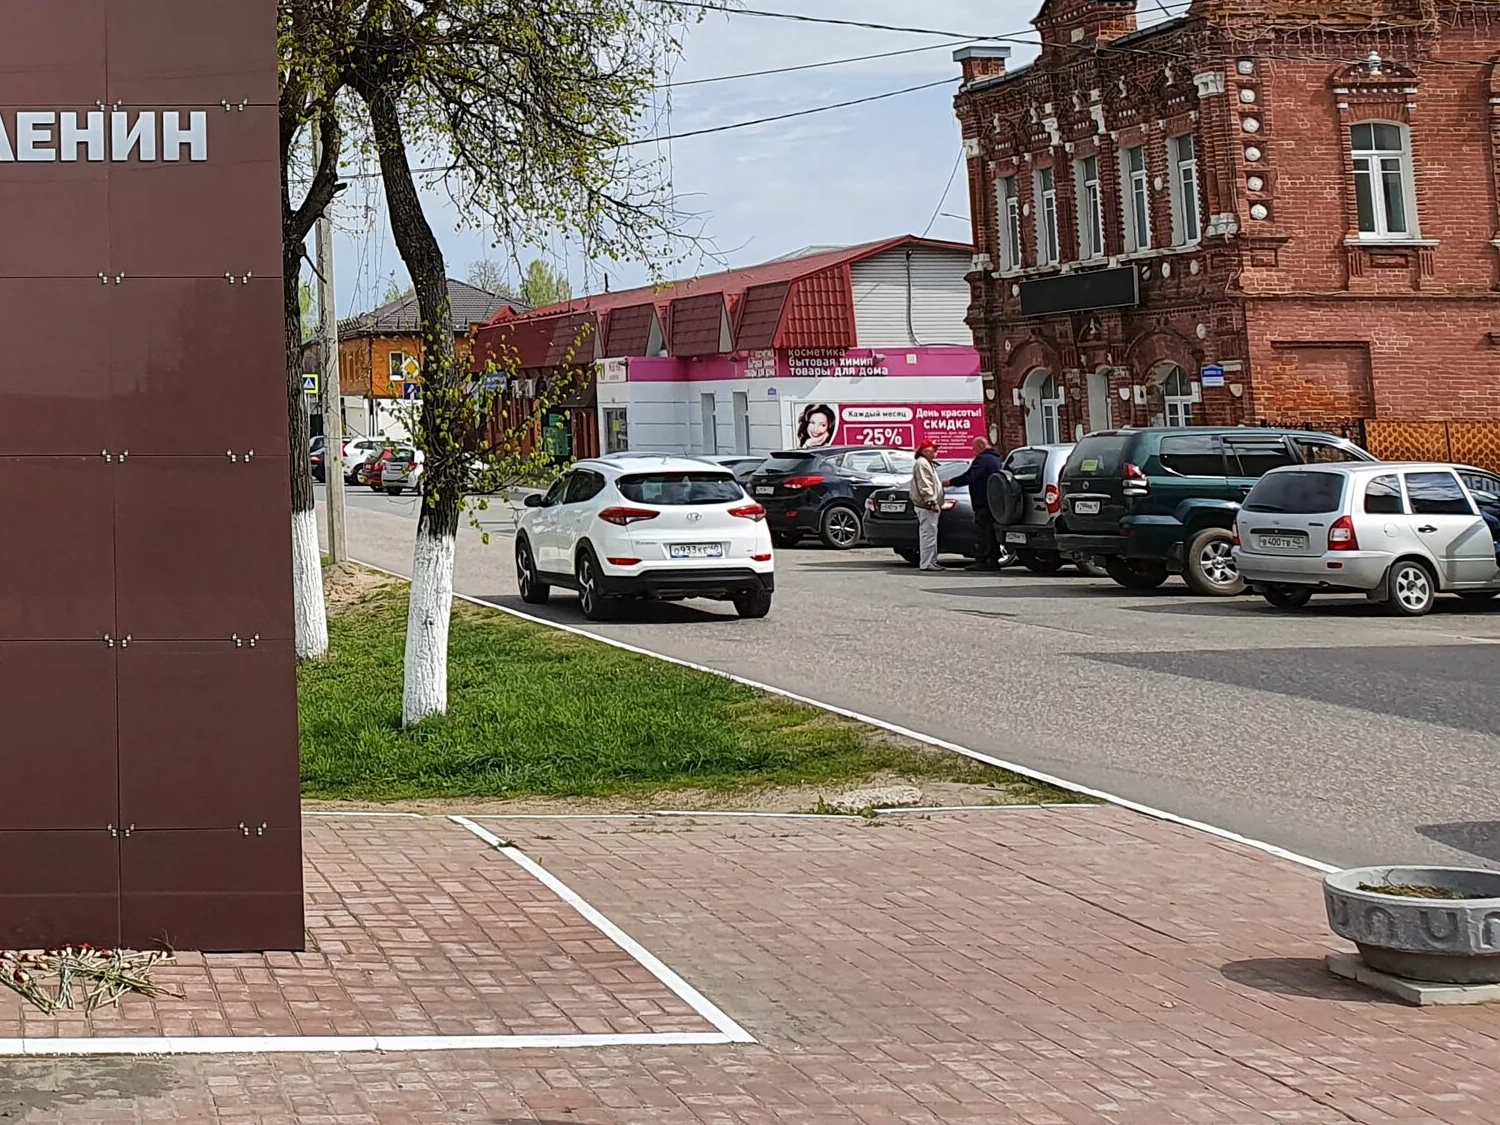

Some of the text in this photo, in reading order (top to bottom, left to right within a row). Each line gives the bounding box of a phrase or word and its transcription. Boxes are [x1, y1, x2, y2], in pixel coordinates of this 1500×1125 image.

[788, 348, 846, 357] косметика
[788, 357, 873, 367] бытовая химия
[789, 367, 888, 377] товары для дома
[848, 410, 880, 418] Каждый
[916, 408, 982, 418] День красоты!
